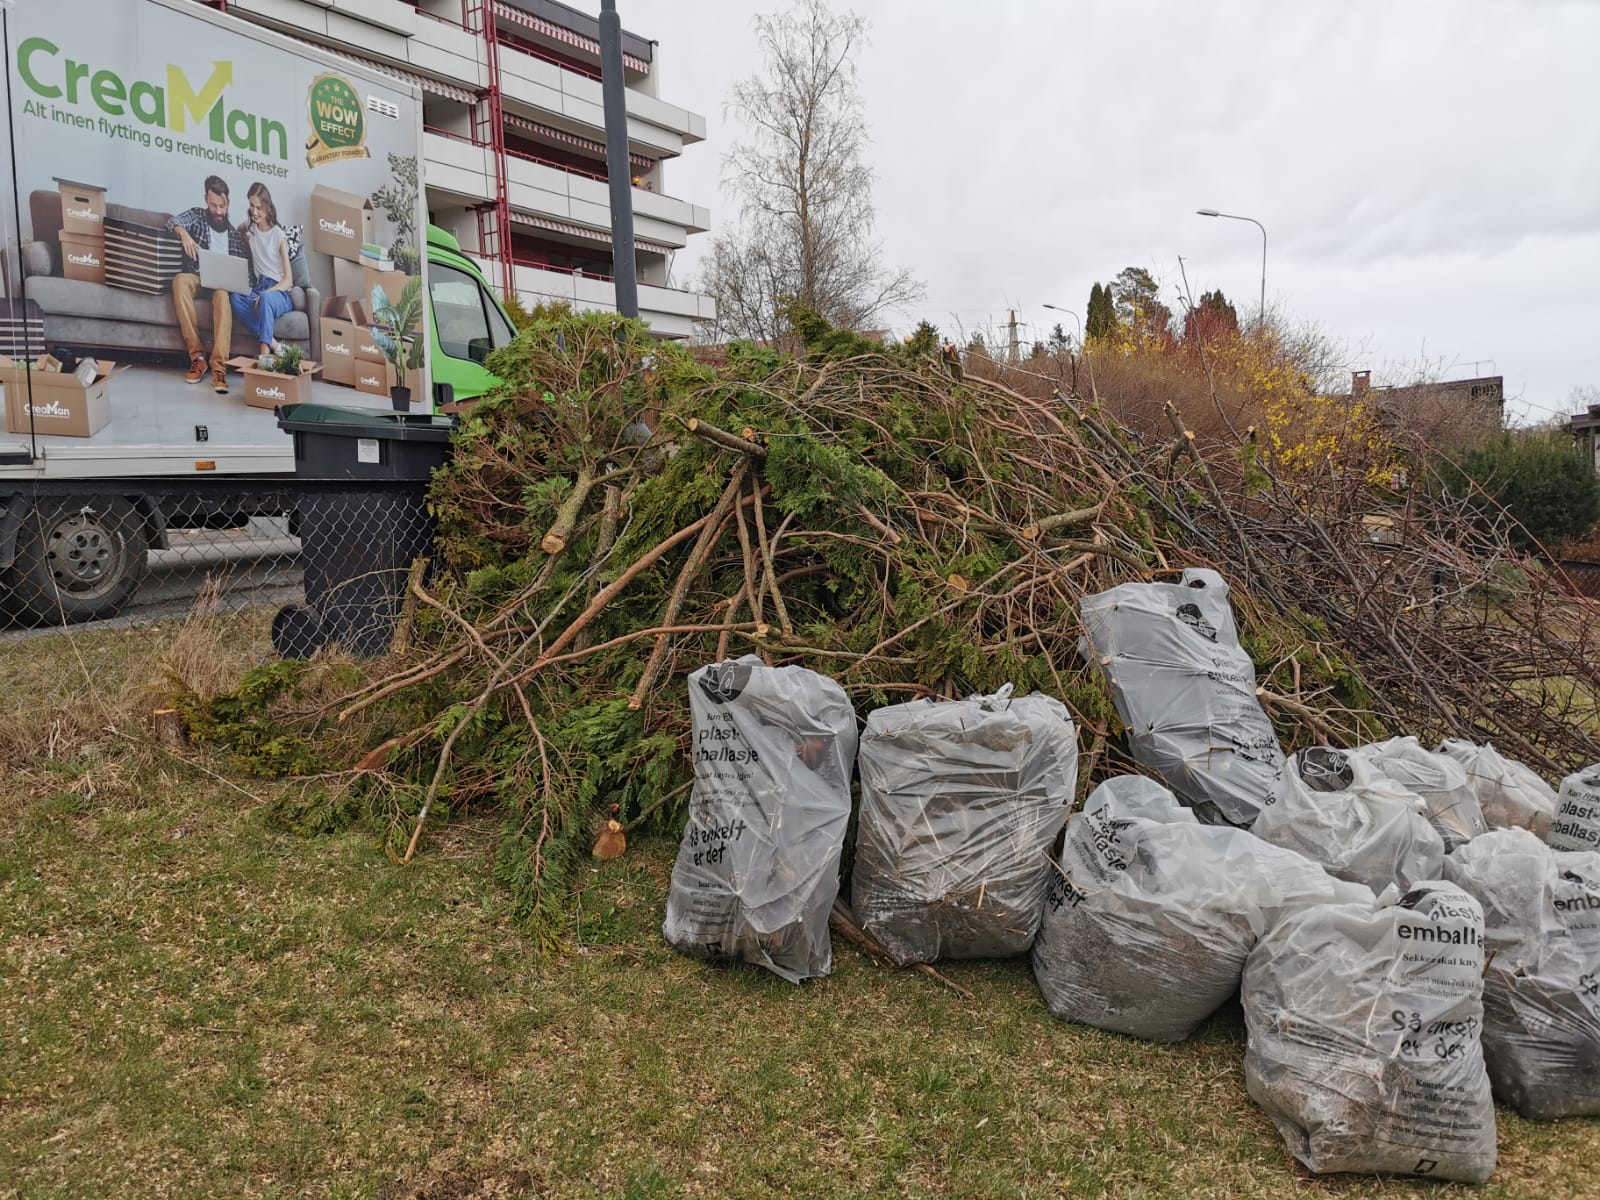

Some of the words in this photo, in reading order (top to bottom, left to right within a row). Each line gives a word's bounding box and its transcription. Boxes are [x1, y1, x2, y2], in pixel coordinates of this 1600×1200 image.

[16, 36, 288, 161] CreaMan
[330, 95, 344, 106] THE
[316, 99, 359, 127] WOW
[23, 99, 47, 119] Alt
[50, 104, 94, 131] innen
[98, 118, 151, 148] flytting
[155, 135, 173, 153] og
[176, 141, 233, 165] renholds
[235, 153, 289, 180] tjenester
[320, 120, 356, 139] EFFECT
[706, 841, 727, 866] det
[1391, 1009, 1423, 1033] Så
